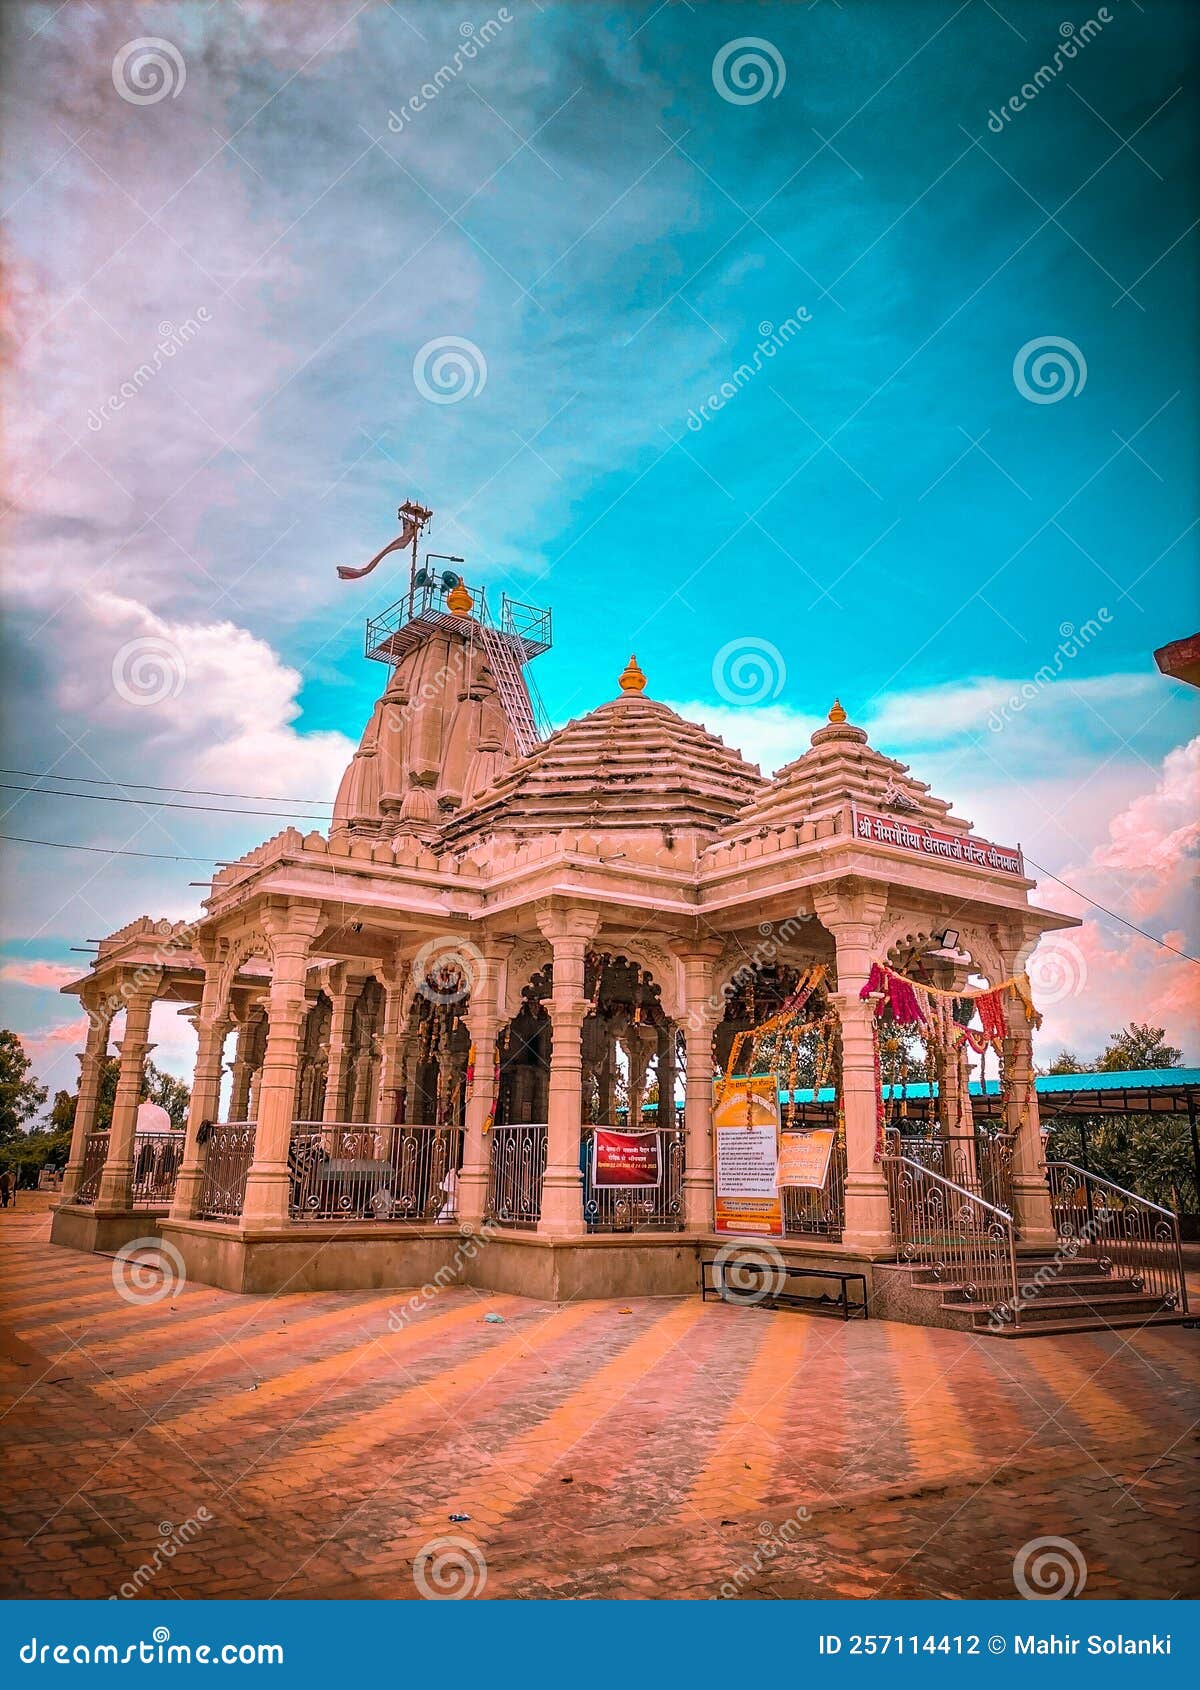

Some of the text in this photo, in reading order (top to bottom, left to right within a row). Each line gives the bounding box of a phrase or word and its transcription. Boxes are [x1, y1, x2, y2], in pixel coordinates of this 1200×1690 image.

[859, 816, 872, 838] श्री
[922, 829, 963, 859] खेतलाजी
[963, 842, 987, 866] मन्दिर
[988, 847, 1021, 873] भीनमाल
